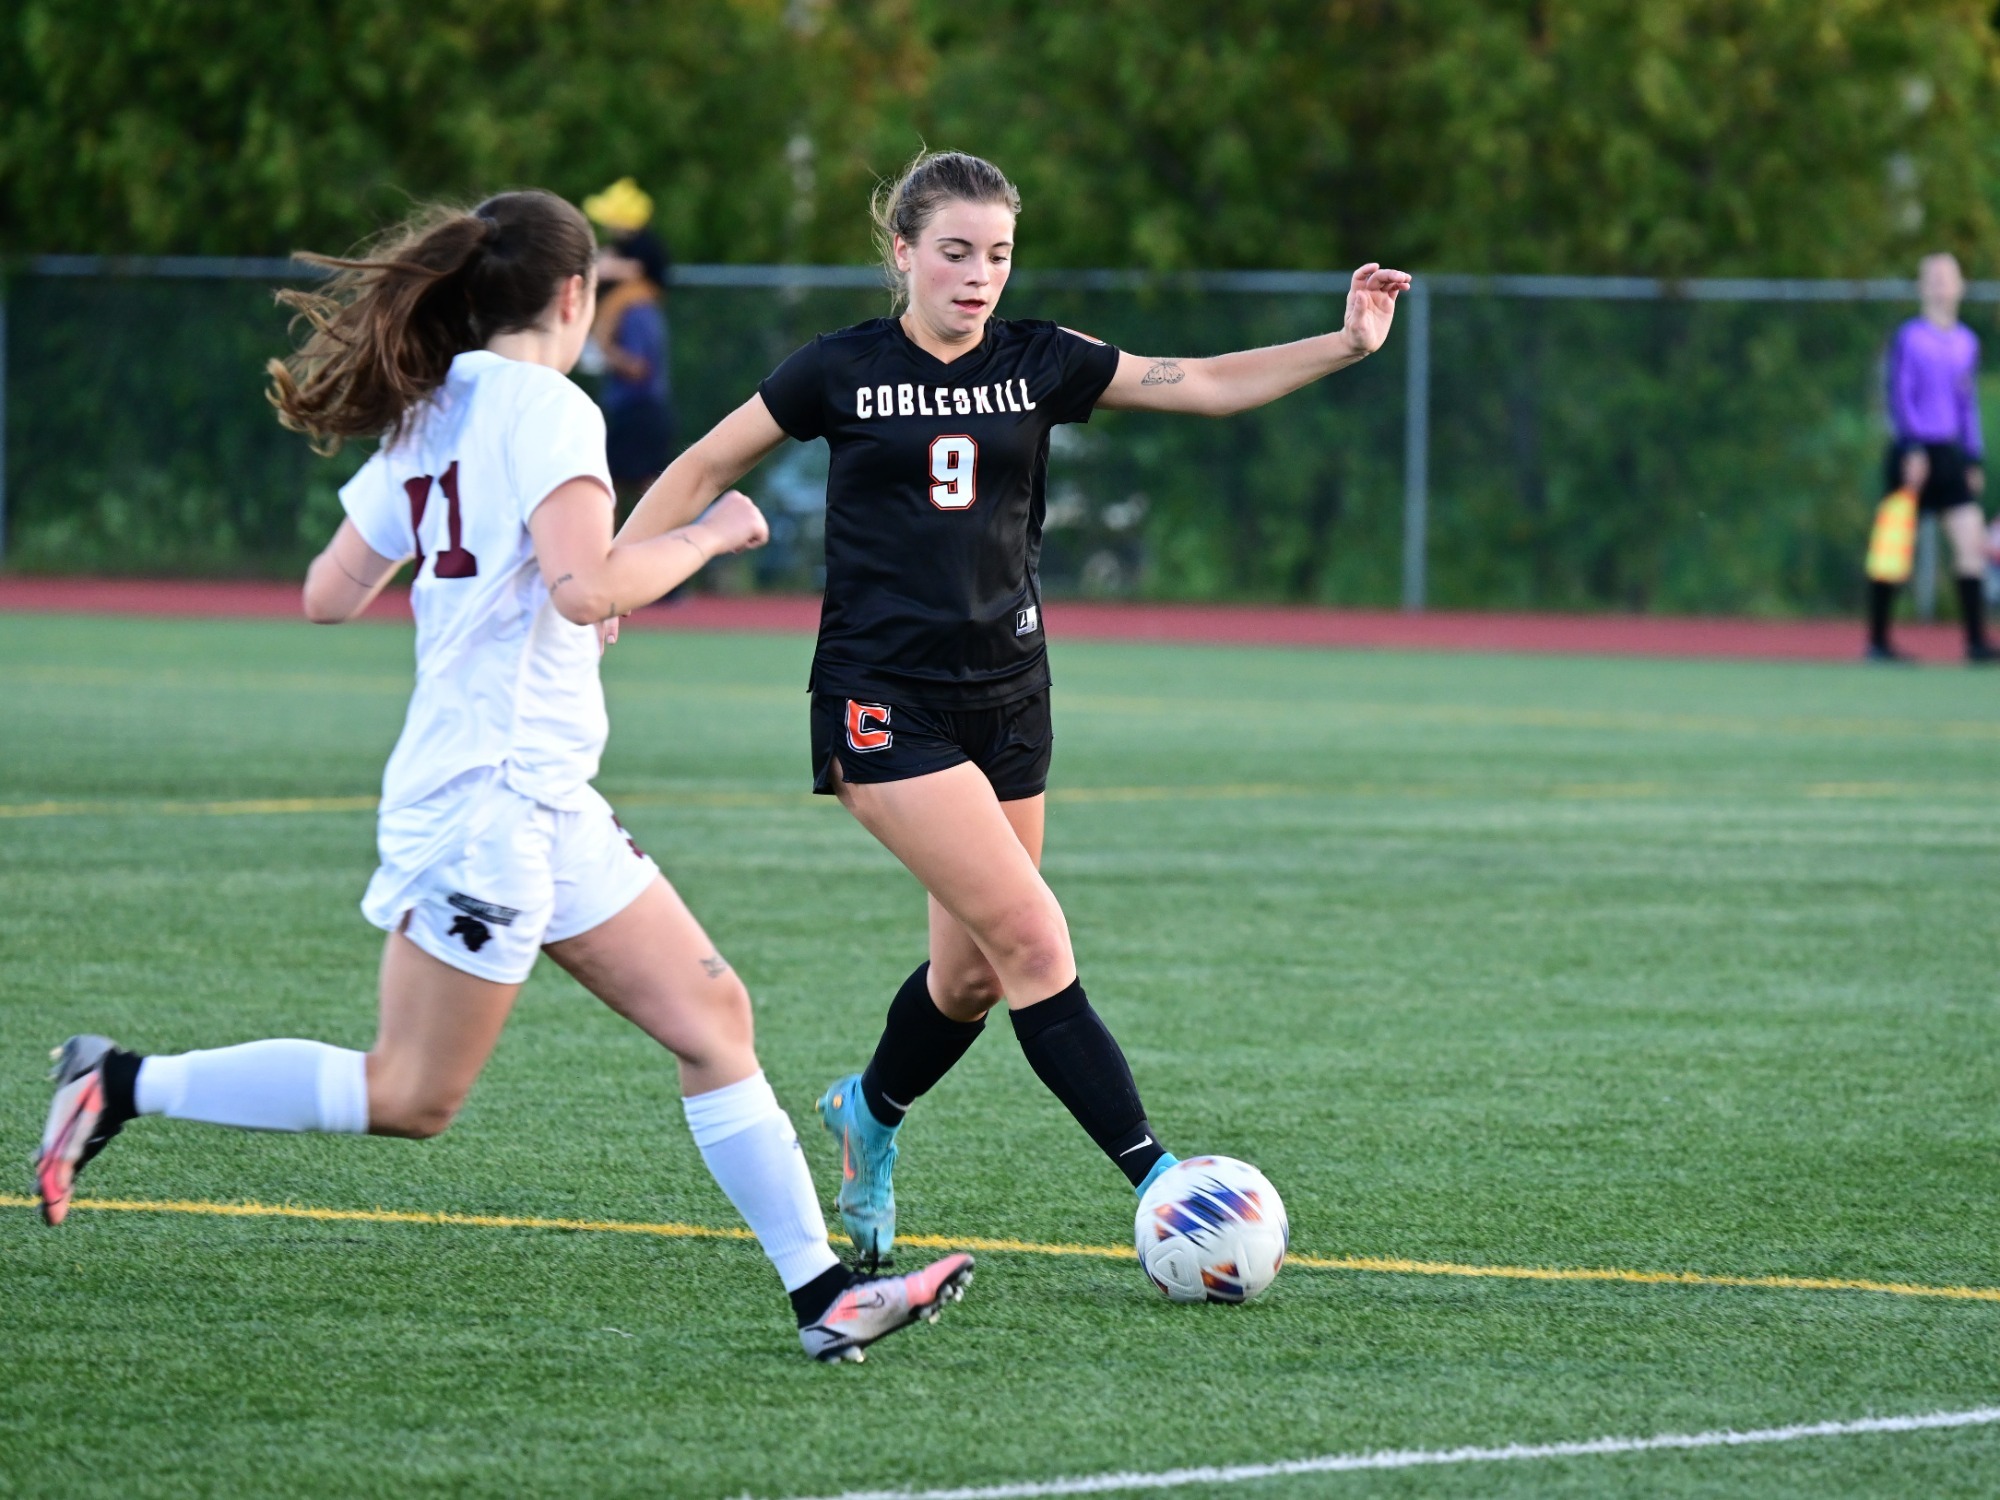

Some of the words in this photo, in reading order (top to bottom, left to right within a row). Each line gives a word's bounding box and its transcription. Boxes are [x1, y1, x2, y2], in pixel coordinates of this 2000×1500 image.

[856, 378, 1036, 419] COBLESKILL
[929, 434, 978, 510] 9
[845, 698, 893, 753] C
